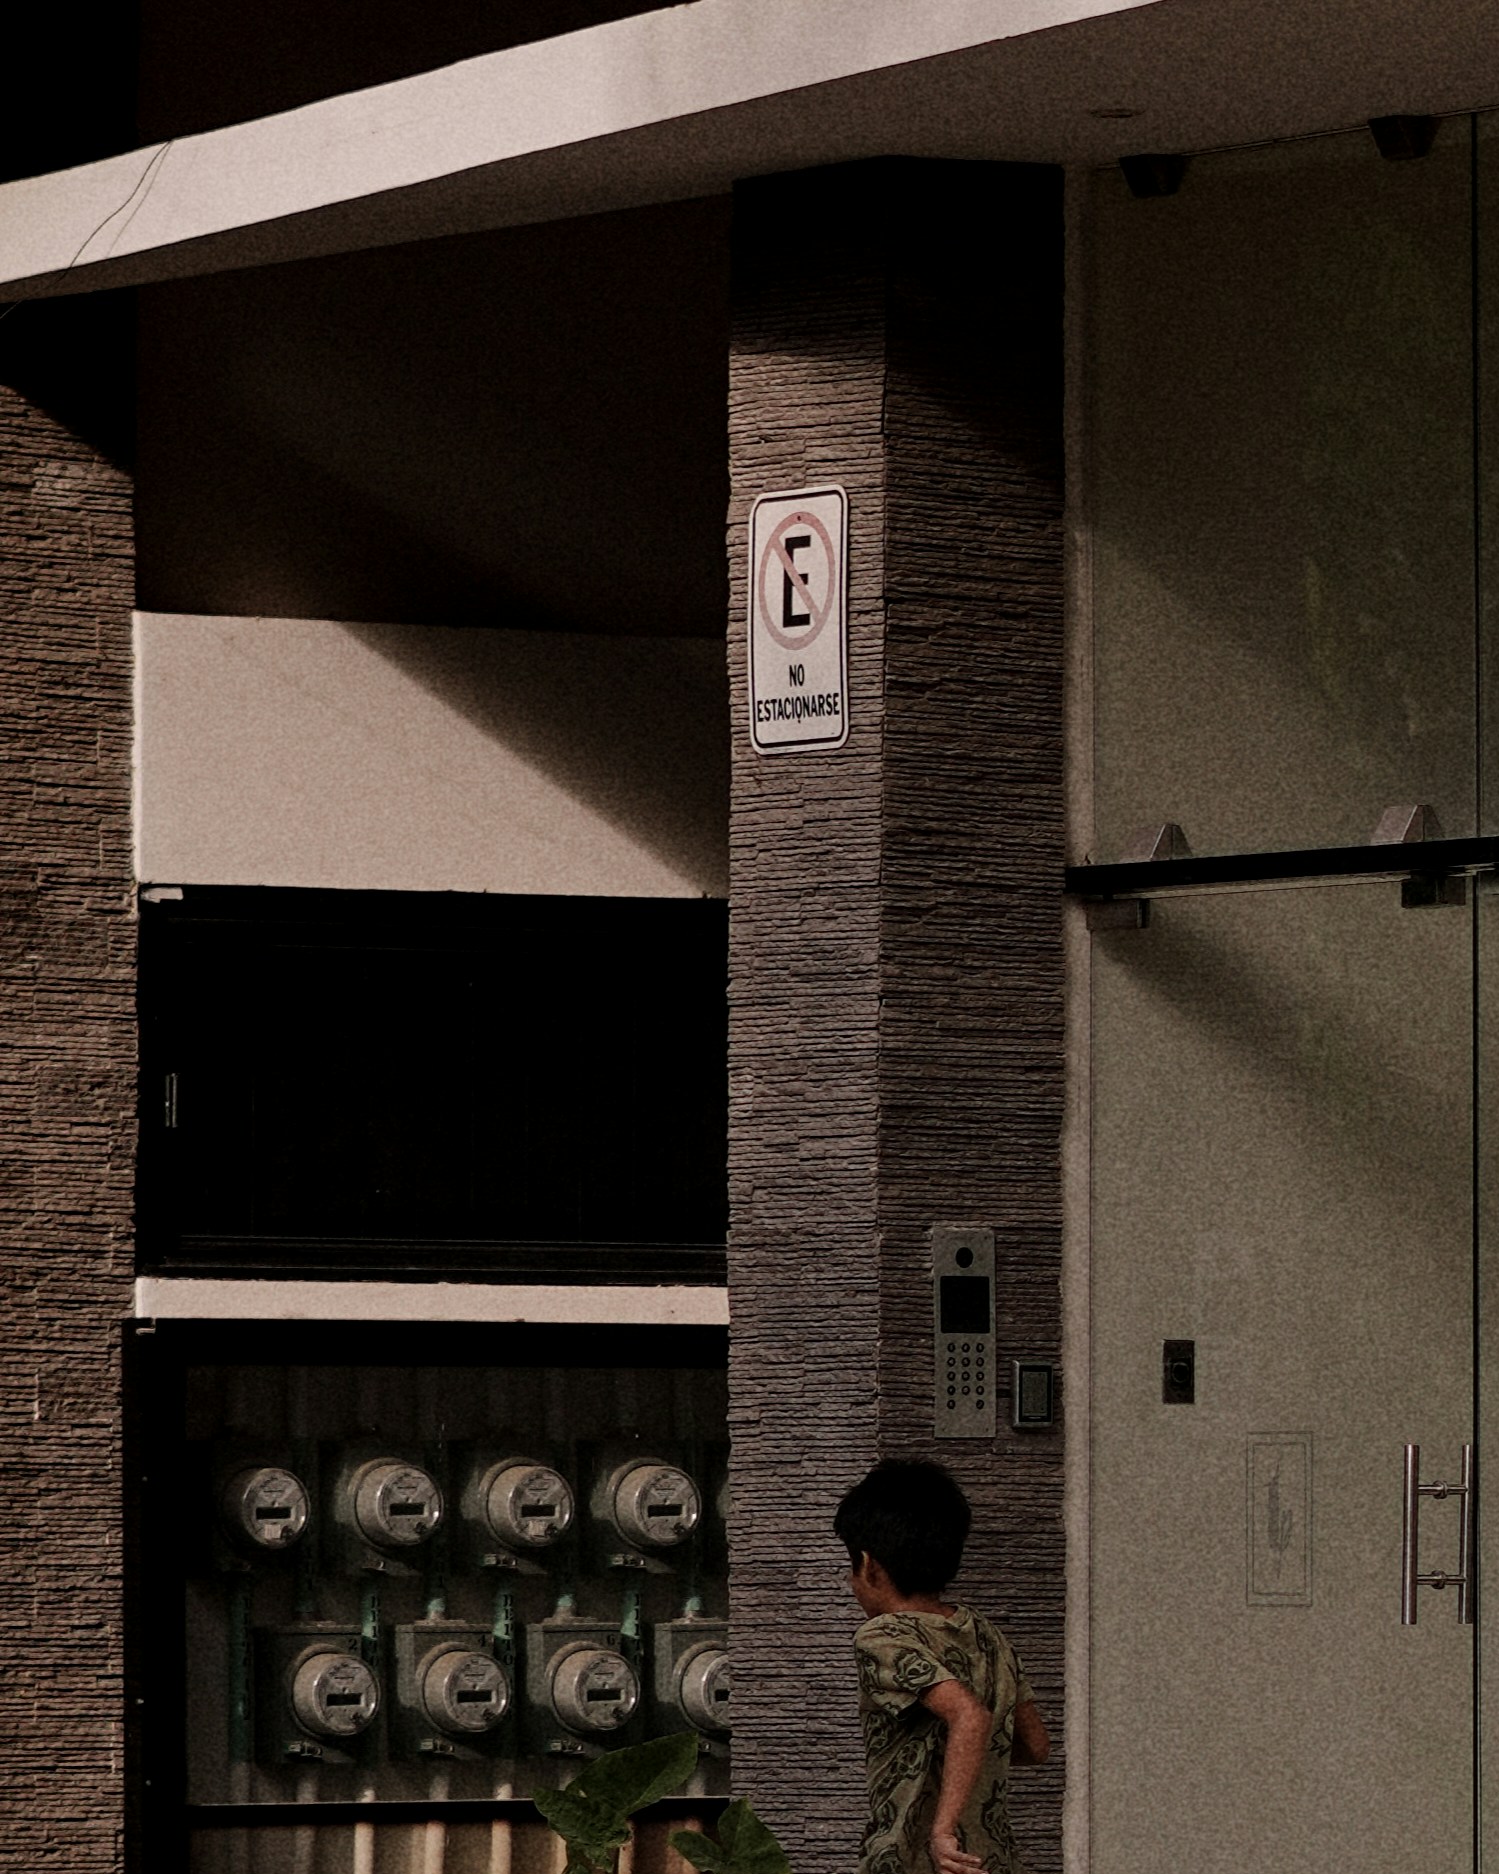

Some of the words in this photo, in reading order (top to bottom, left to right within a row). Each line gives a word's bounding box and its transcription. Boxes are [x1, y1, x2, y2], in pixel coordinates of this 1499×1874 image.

[783, 535, 811, 628] E
[789, 663, 805, 687] NO
[757, 692, 840, 722] ESTACIONARSE
